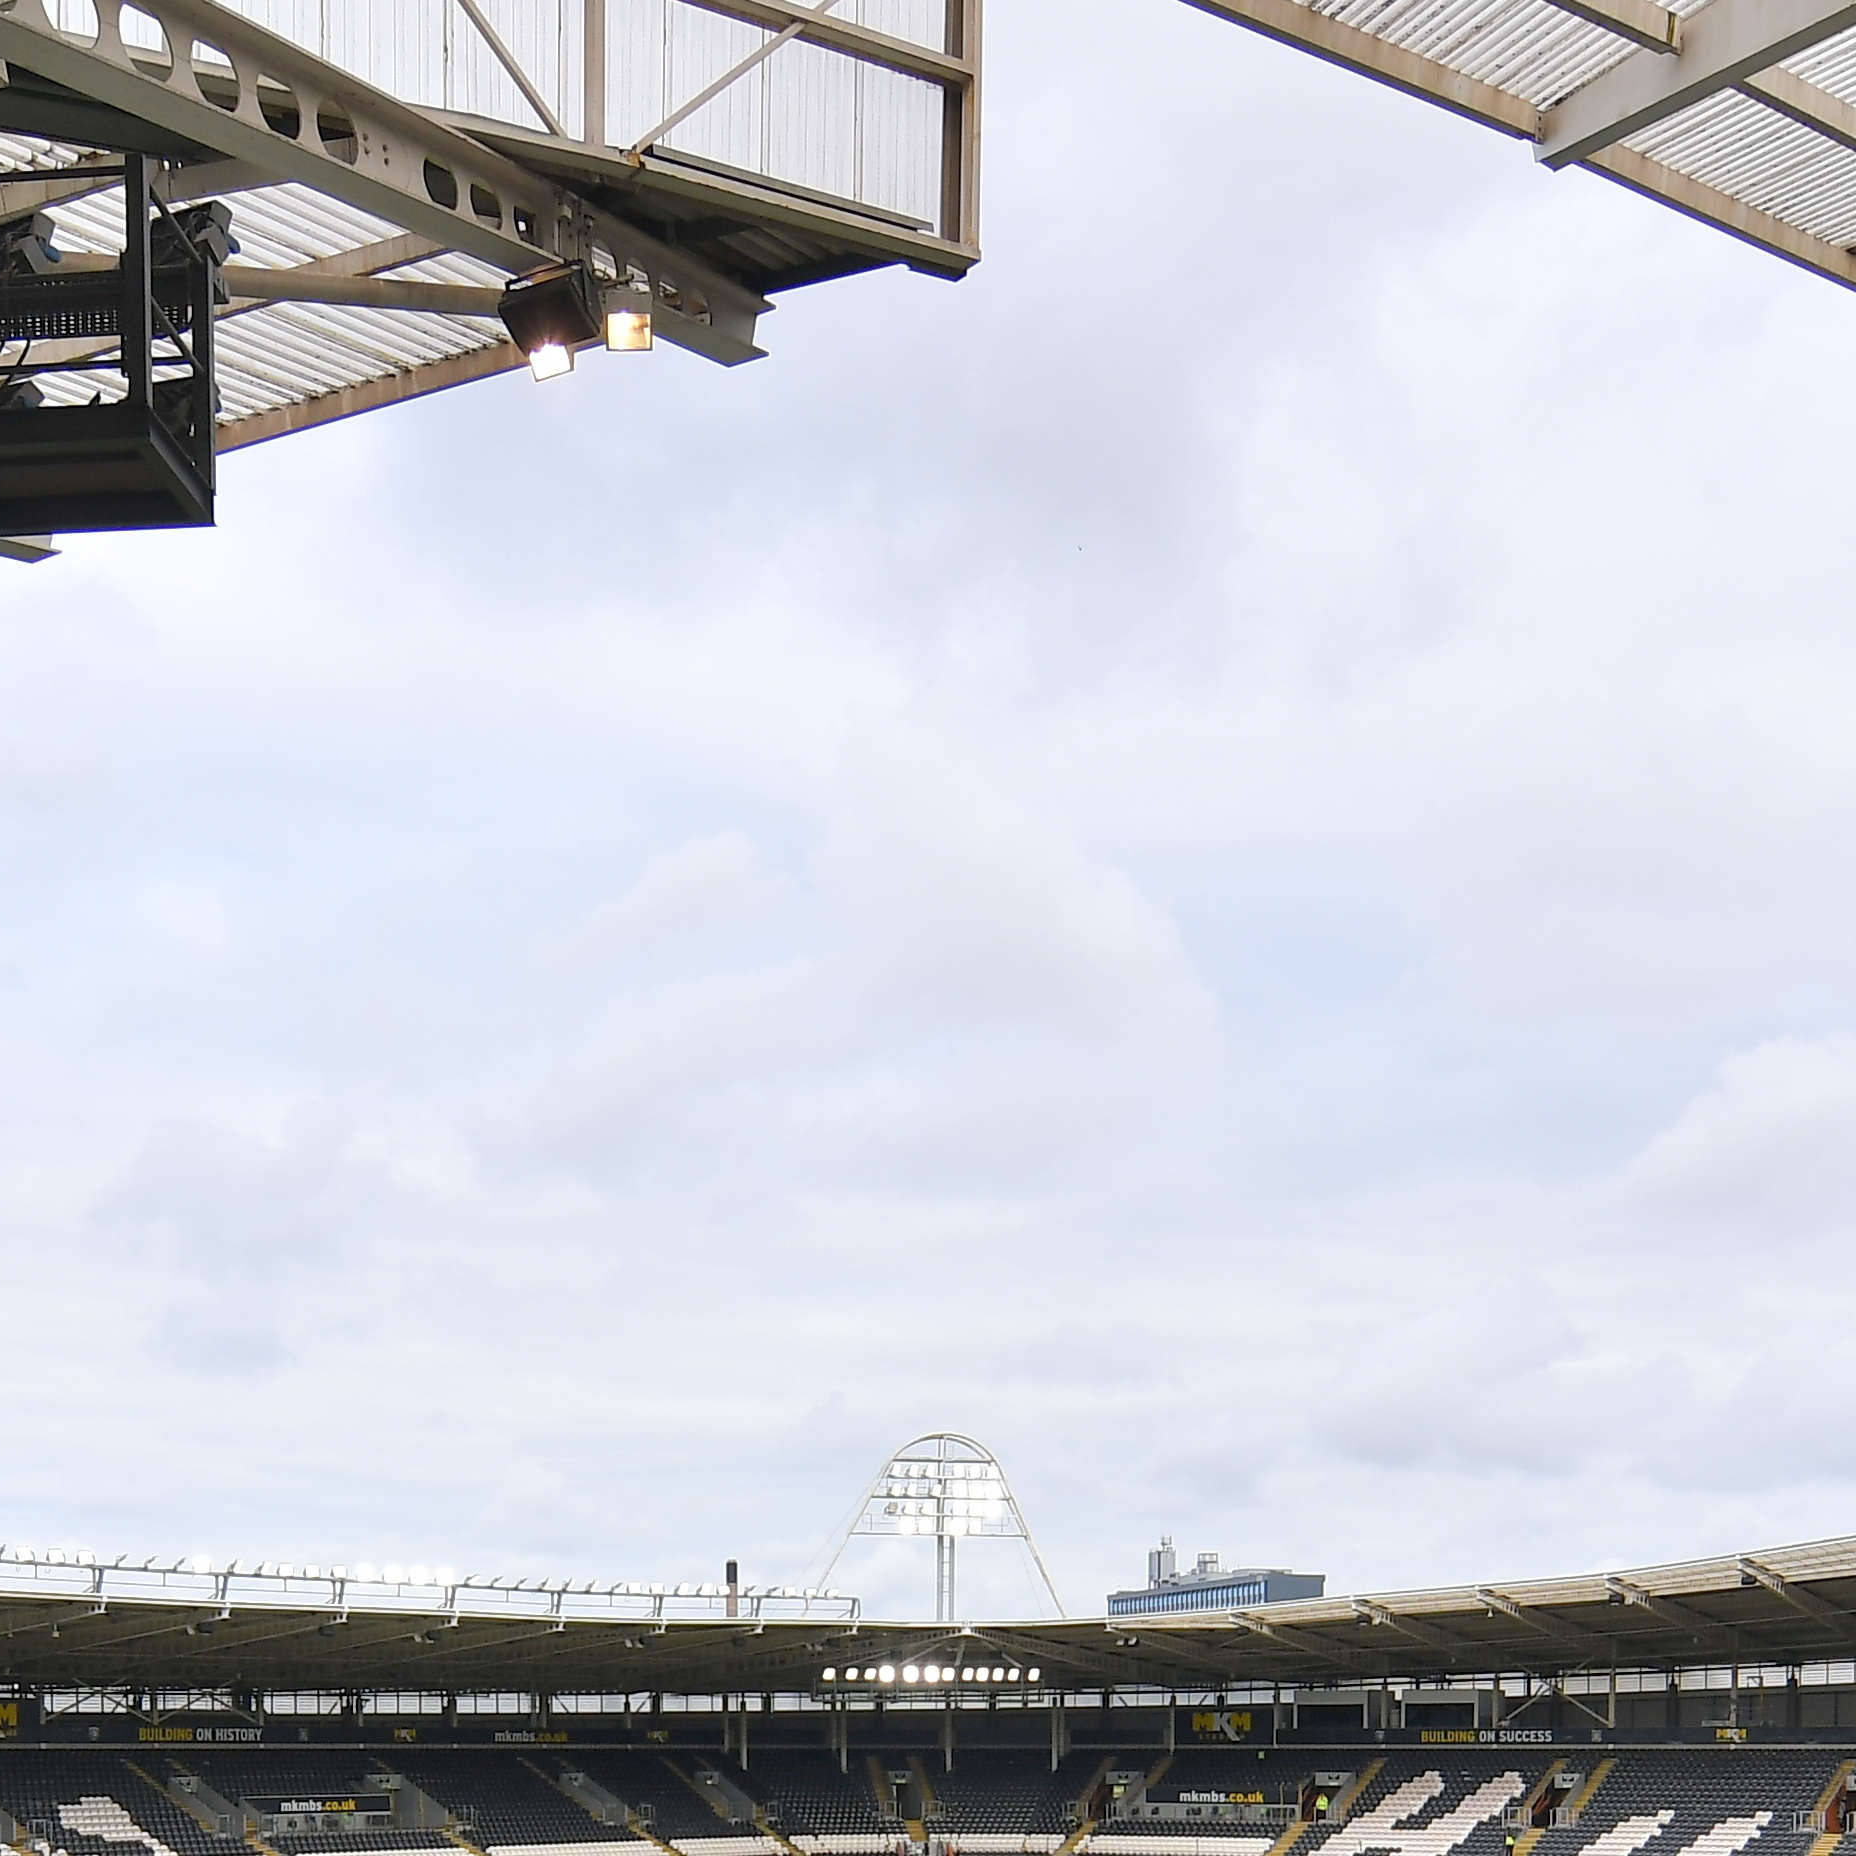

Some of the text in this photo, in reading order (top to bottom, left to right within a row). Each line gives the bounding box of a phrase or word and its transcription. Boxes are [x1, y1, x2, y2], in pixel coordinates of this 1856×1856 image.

[1192, 1712, 1252, 1741] MKM
[139, 1727, 263, 1741] BUILDING ON HISTORY
[1421, 1730, 1552, 1743] BUILDING ON SUCCESS
[1179, 1790, 1264, 1803] mkmbs.co.uk
[280, 1798, 356, 1812] mkmbs.co.uk
